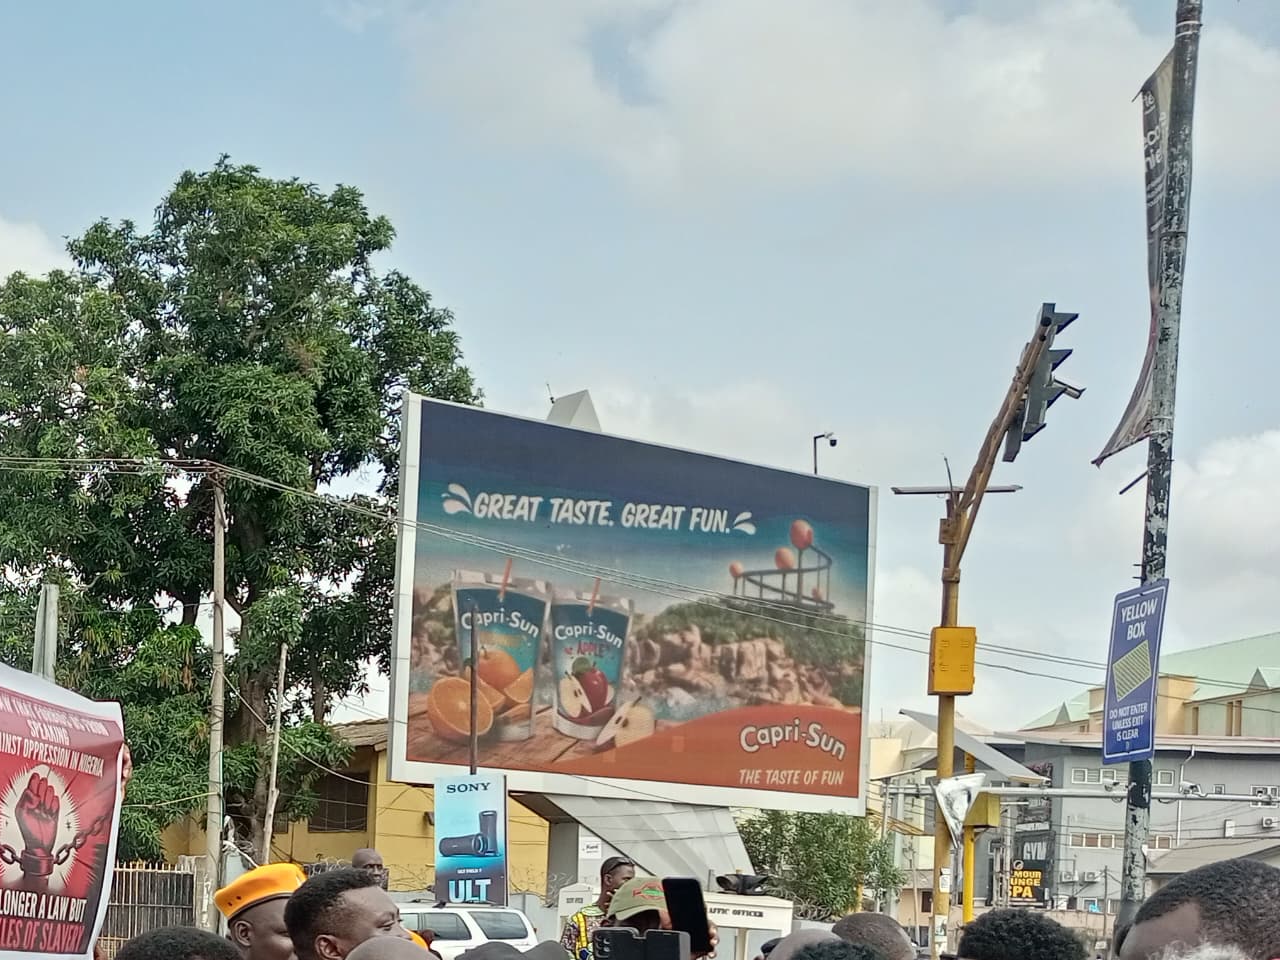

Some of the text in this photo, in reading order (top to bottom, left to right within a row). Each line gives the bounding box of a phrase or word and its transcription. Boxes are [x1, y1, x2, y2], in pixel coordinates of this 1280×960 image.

[473, 492, 731, 535] GREAT TASTE. GREAT FUN.
[1121, 597, 1158, 624] YELLOW
[461, 607, 540, 638] Capri-Sun
[1127, 621, 1147, 641] BOX
[554, 621, 623, 648] Capri-Sun
[1109, 707, 1118, 719] DO
[1130, 702, 1148, 716] ENTER
[1112, 715, 1145, 731] UNLESS EXIT
[740, 718, 846, 761] Capri-Sun
[1122, 729, 1139, 742] CLEAR
[23, 737, 70, 767] OPPRESSION
[70, 748, 80, 770] IN
[446, 782, 491, 794] SONY
[739, 769, 844, 785] THE TASTE OF FUN
[1023, 841, 1047, 861] GYM
[1011, 879, 1041, 887] UNGE
[1012, 871, 1042, 879] MOUR
[448, 878, 492, 904] ULT
[38, 894, 46, 919] A
[47, 895, 69, 920] LAW
[68, 898, 87, 922] BUT
[23, 920, 41, 950] OF
[40, 921, 85, 952] SLAVERY
